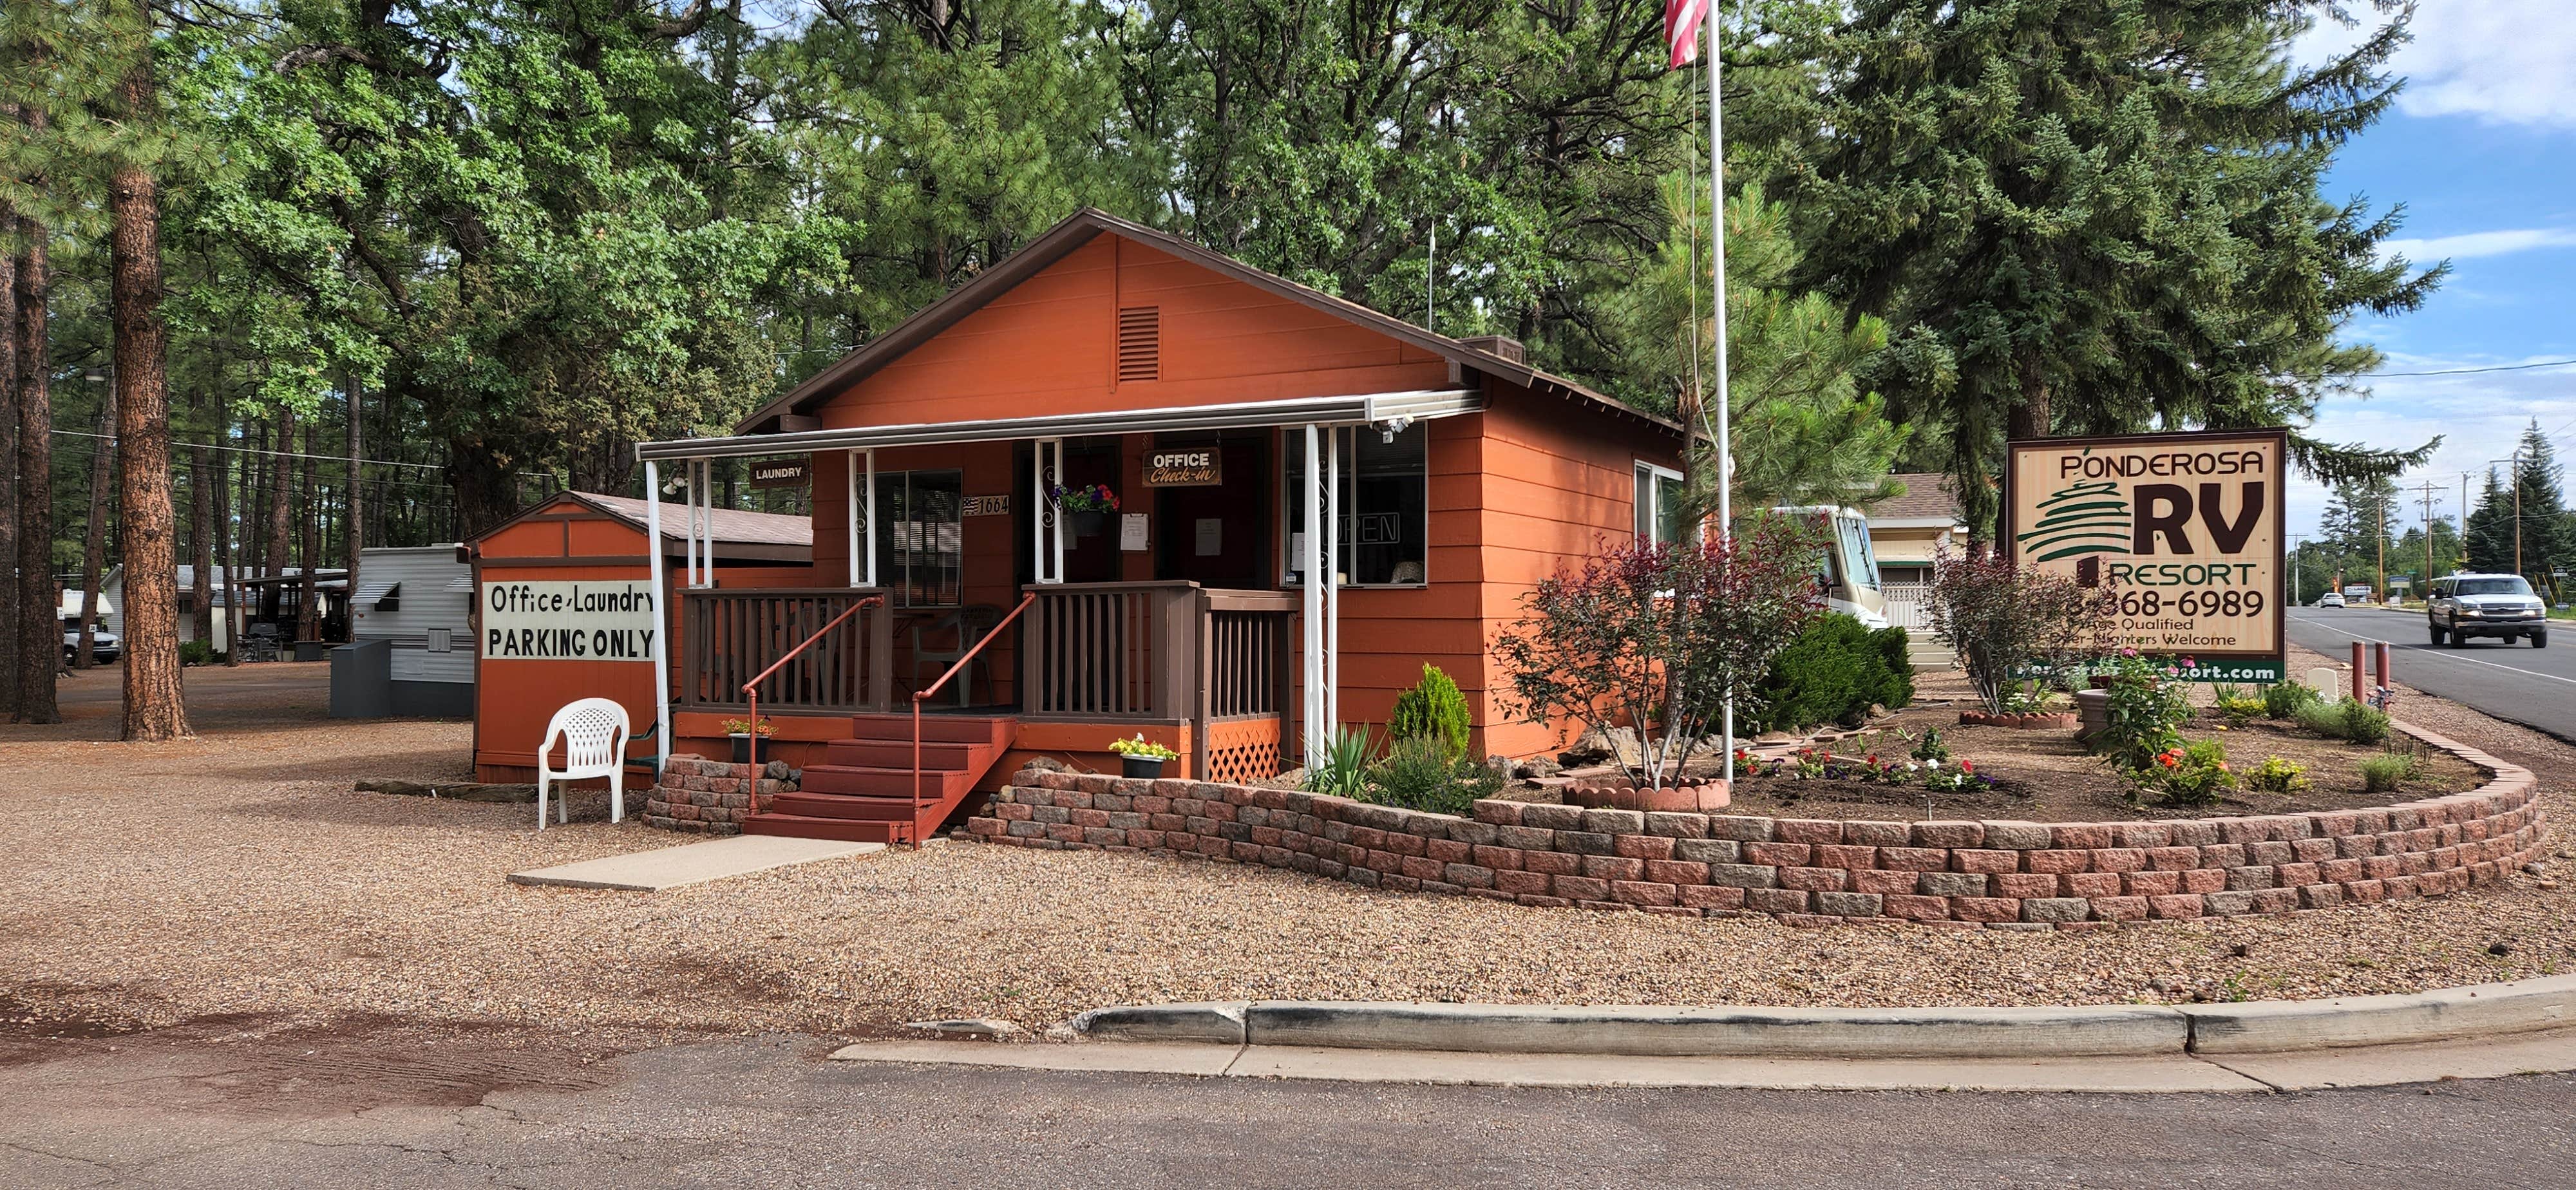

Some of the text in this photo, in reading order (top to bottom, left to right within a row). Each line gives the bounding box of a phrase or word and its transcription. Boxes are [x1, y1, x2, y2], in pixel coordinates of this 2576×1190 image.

[1153, 453, 1209, 468] OFFICE
[2061, 451, 2263, 478] PONDEROSA
[755, 467, 802, 480] LAUNDRY
[1150, 466, 1216, 483] Check-in
[979, 496, 1009, 514] 1664
[2133, 482, 2264, 554] RV
[2110, 563, 2257, 586] RESORT
[2121, 618, 2193, 631] Qualified
[489, 628, 655, 657] PARKING ONLY
[2163, 633, 2236, 645] Welcome
